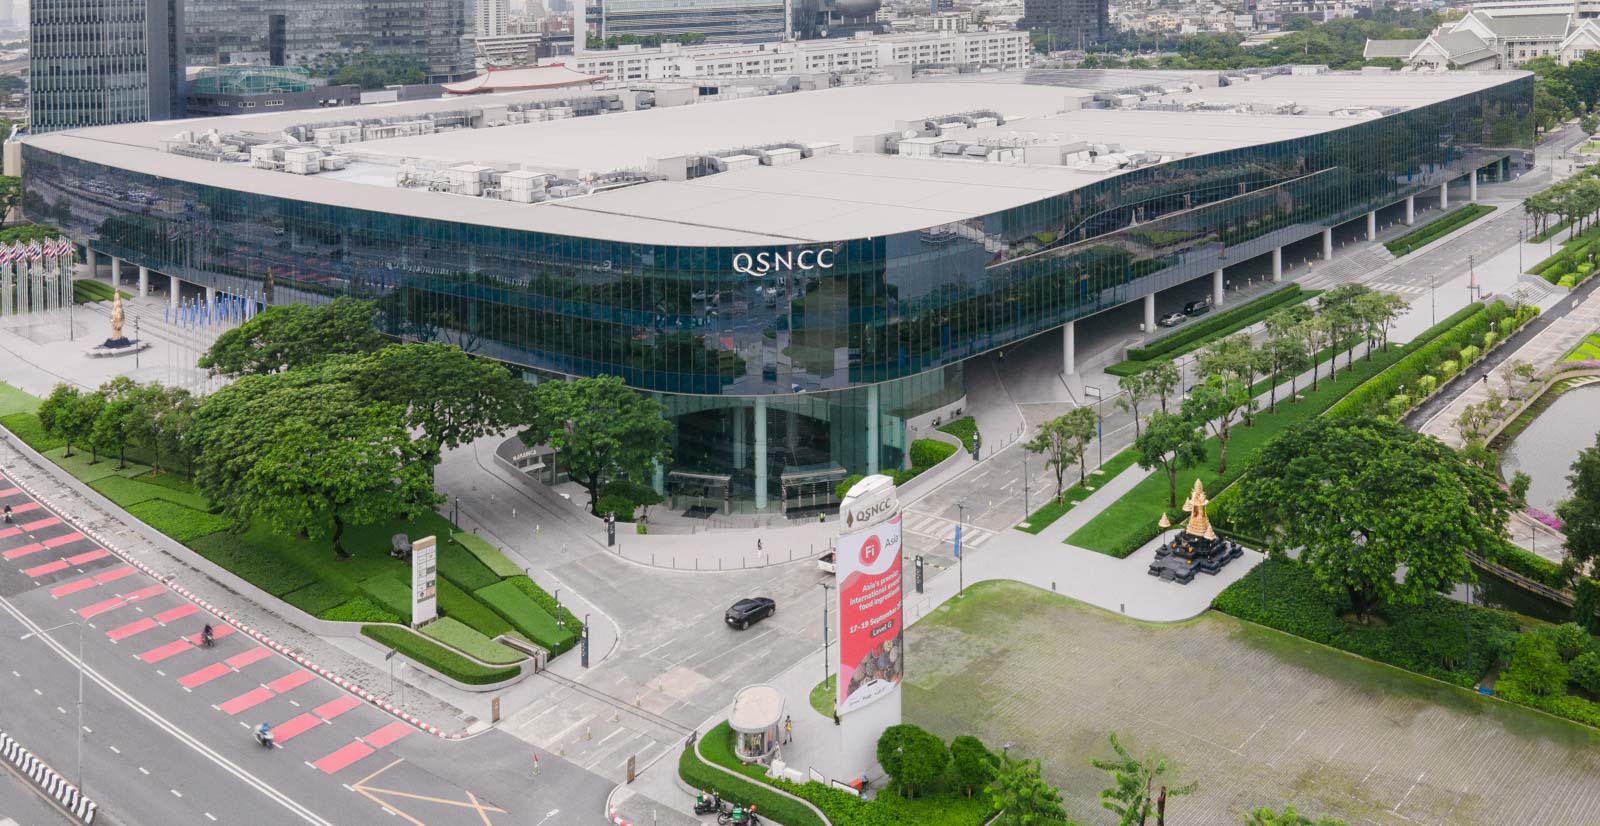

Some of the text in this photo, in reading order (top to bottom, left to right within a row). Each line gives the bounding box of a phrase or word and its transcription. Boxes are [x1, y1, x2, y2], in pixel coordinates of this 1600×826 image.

[732, 248, 834, 277] QSNCC
[856, 498, 891, 521] QSNCC
[865, 534, 899, 559] Fi Asia
[849, 584, 887, 606] international
[862, 580, 880, 592] Asia's
[859, 599, 874, 611] food
[870, 607, 897, 626] September
[872, 623, 887, 636] Level
